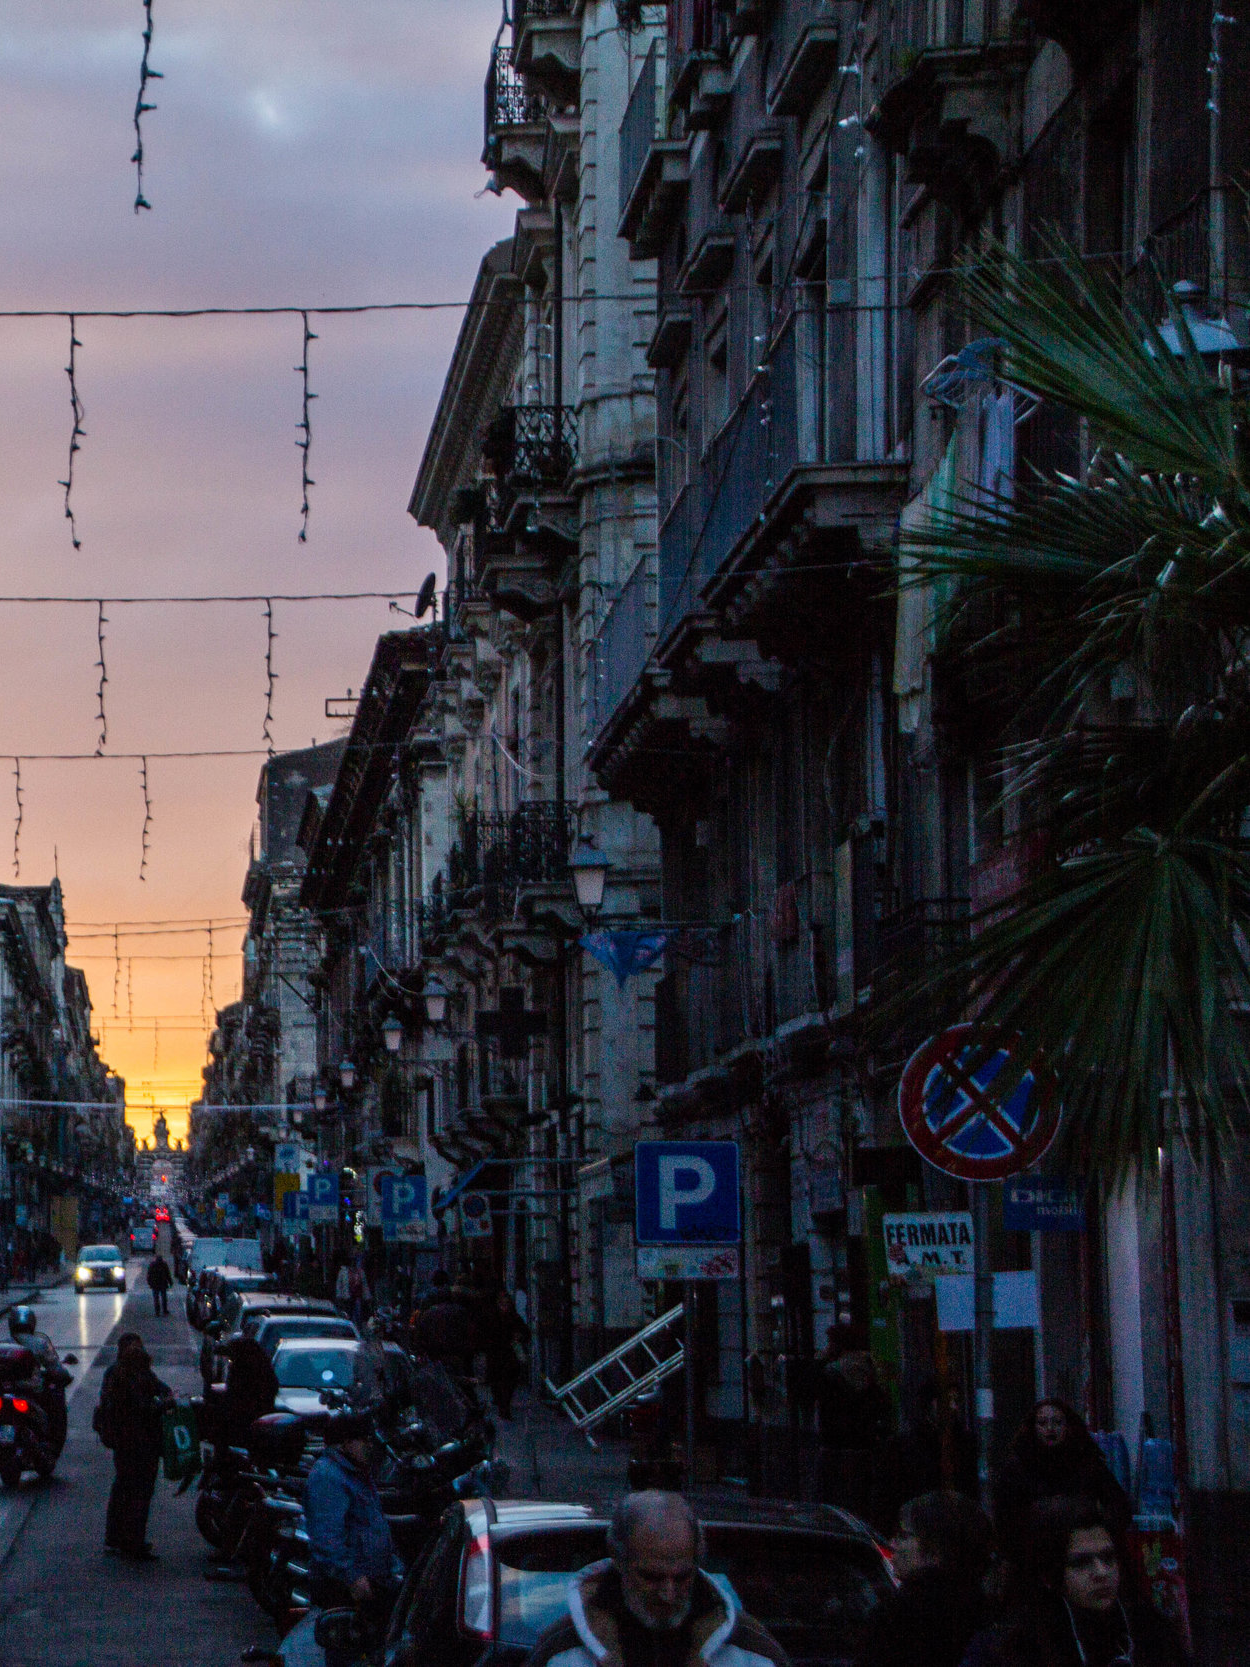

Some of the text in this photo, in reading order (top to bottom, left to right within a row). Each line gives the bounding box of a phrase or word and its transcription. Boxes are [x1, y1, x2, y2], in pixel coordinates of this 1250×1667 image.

[314, 1178, 332, 1200] P
[392, 1182, 416, 1214] P
[658, 1155, 716, 1230] P
[885, 1222, 971, 1245] FERMATA
